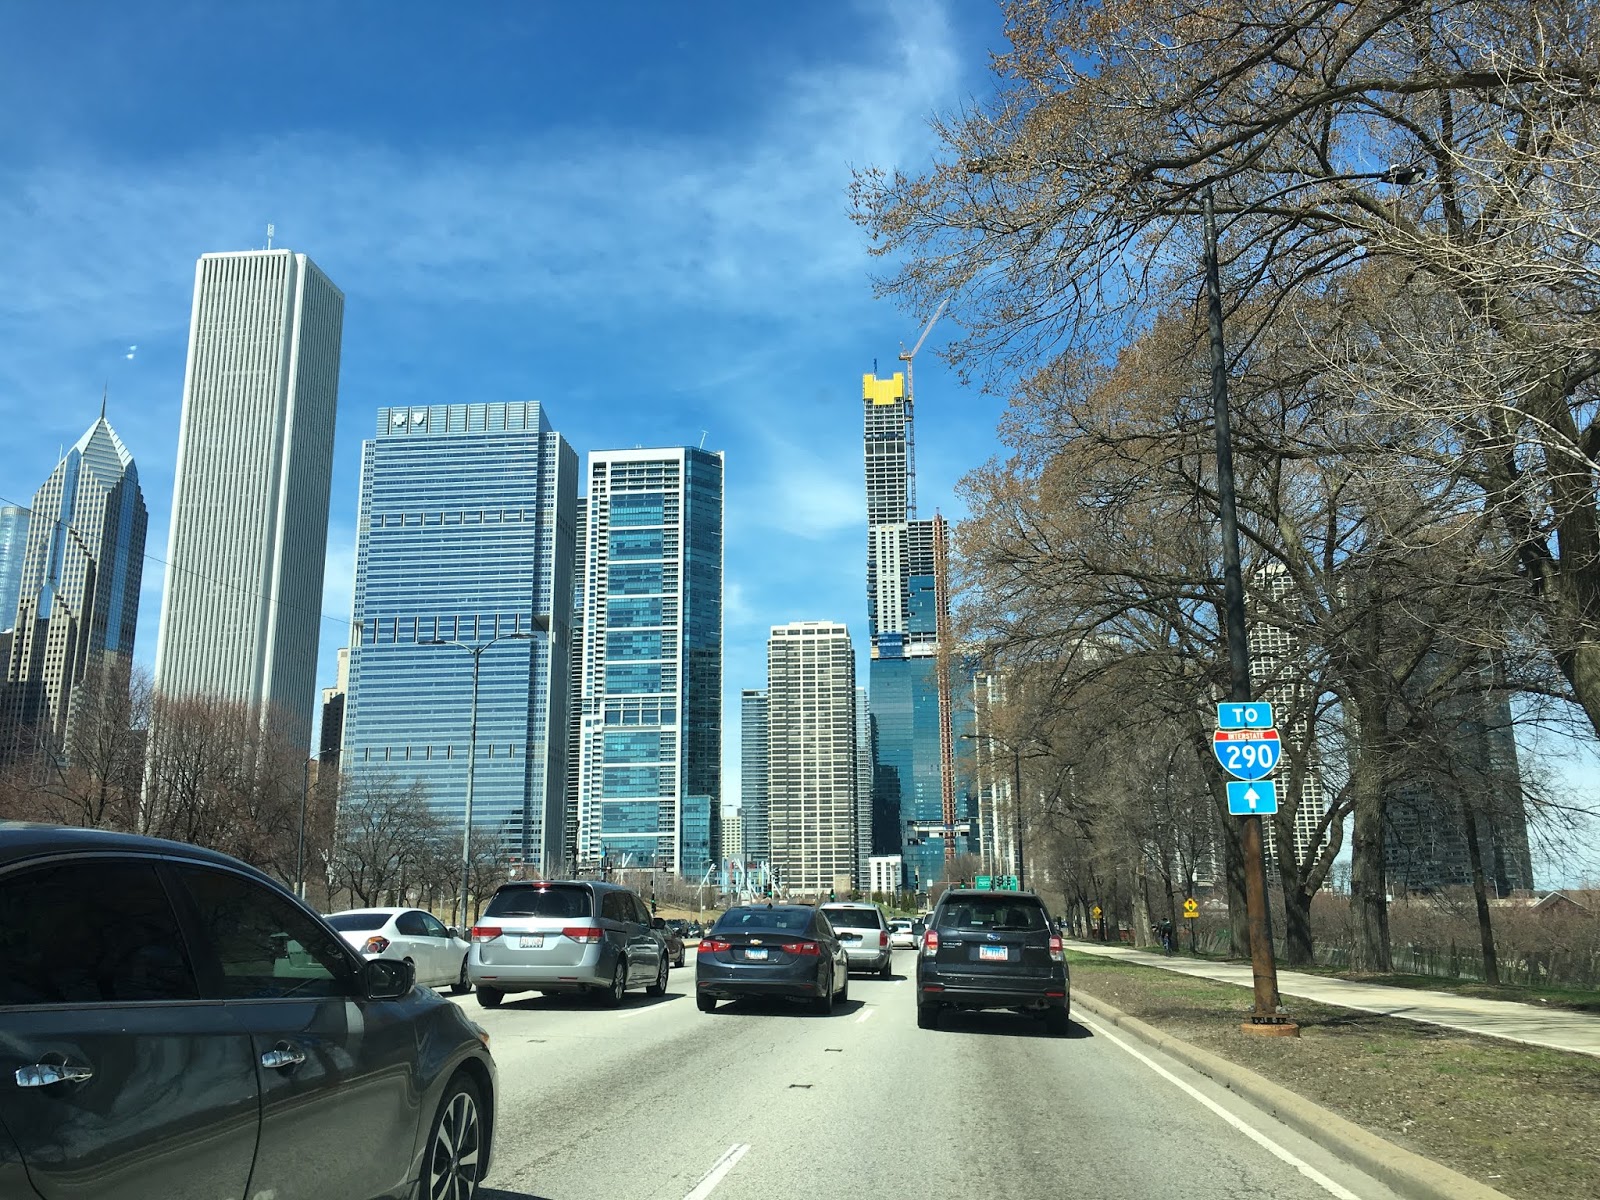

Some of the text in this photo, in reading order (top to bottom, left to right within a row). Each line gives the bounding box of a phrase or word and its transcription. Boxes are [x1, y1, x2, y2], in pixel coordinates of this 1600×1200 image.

[1232, 708, 1258, 723] TO
[1227, 732, 1265, 741] INTERSTATE
[1226, 744, 1273, 769] 290
